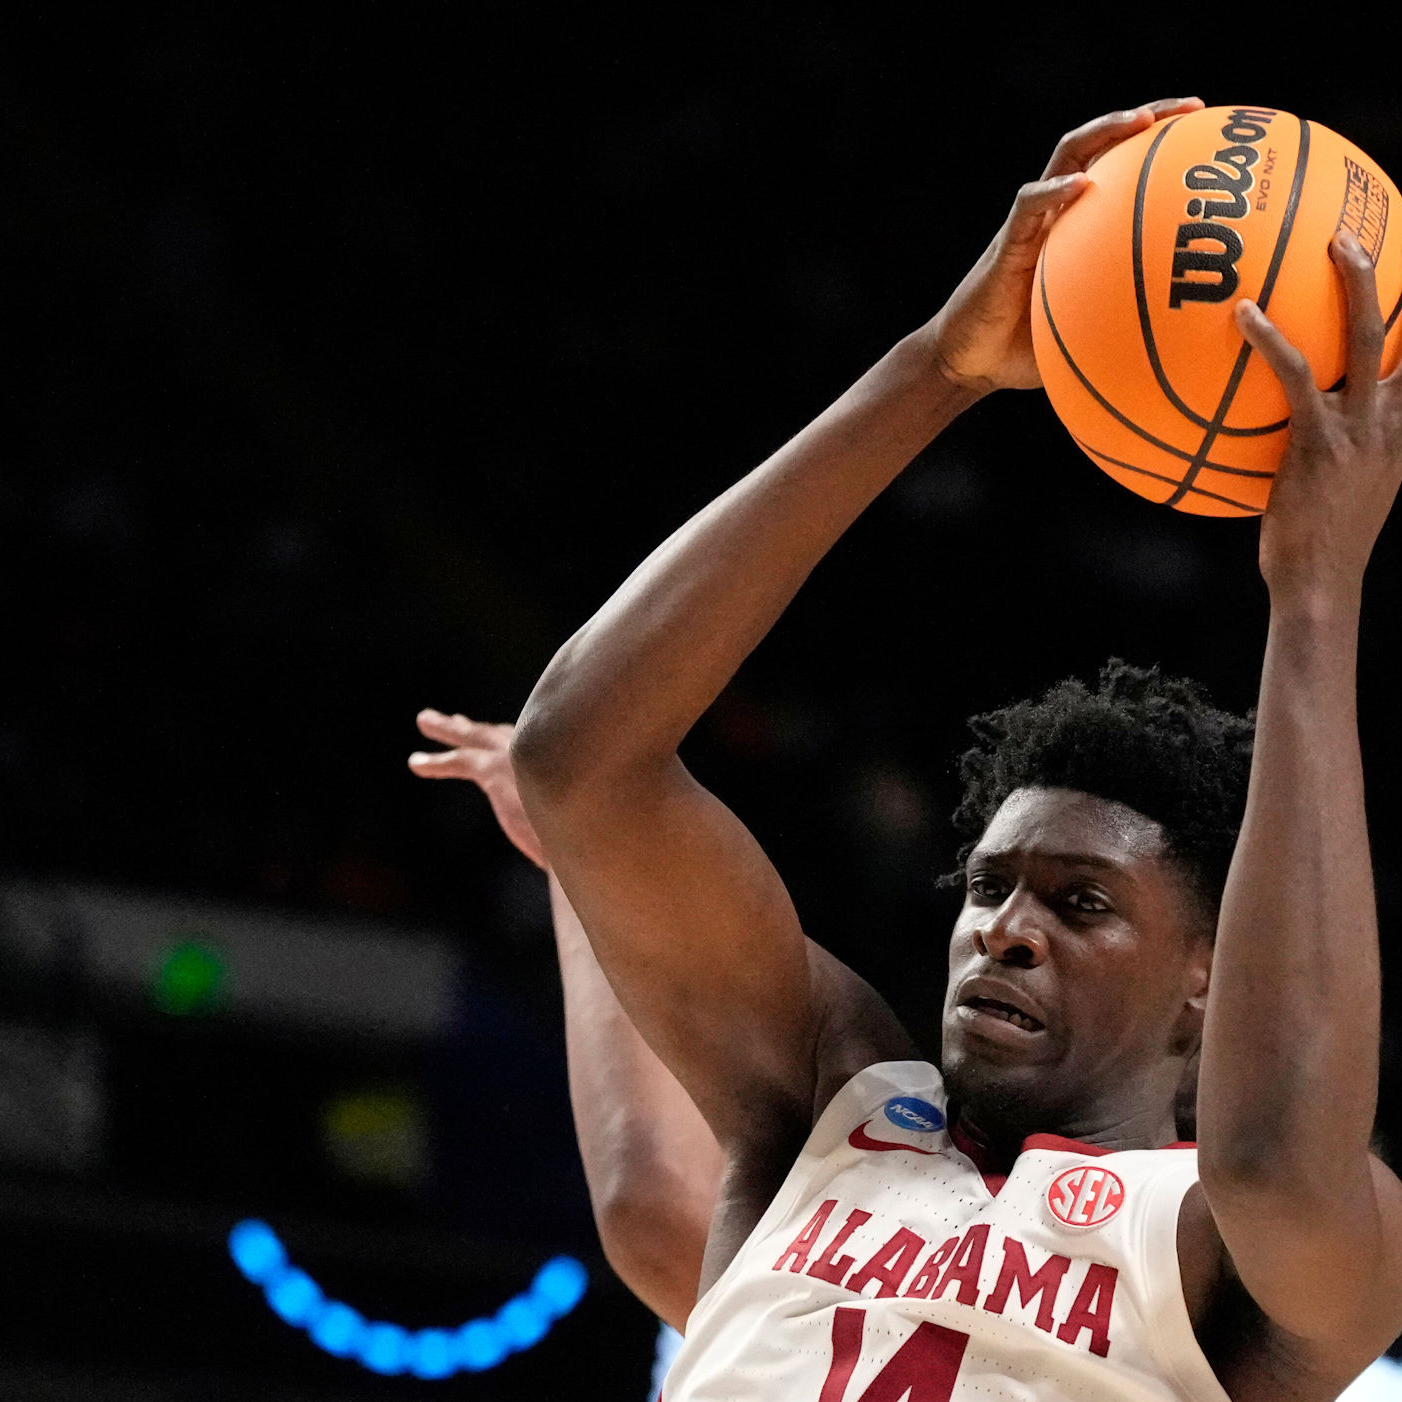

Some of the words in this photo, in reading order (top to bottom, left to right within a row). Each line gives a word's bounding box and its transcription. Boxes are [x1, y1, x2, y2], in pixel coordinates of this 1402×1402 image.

[1263, 147, 1279, 174] NXT
[1169, 108, 1278, 310] Wilson
[1256, 176, 1271, 211] EVO
[889, 1103, 935, 1129] NCAA
[1050, 1167, 1122, 1224] SEC
[771, 1199, 1120, 1358] ALABAMA
